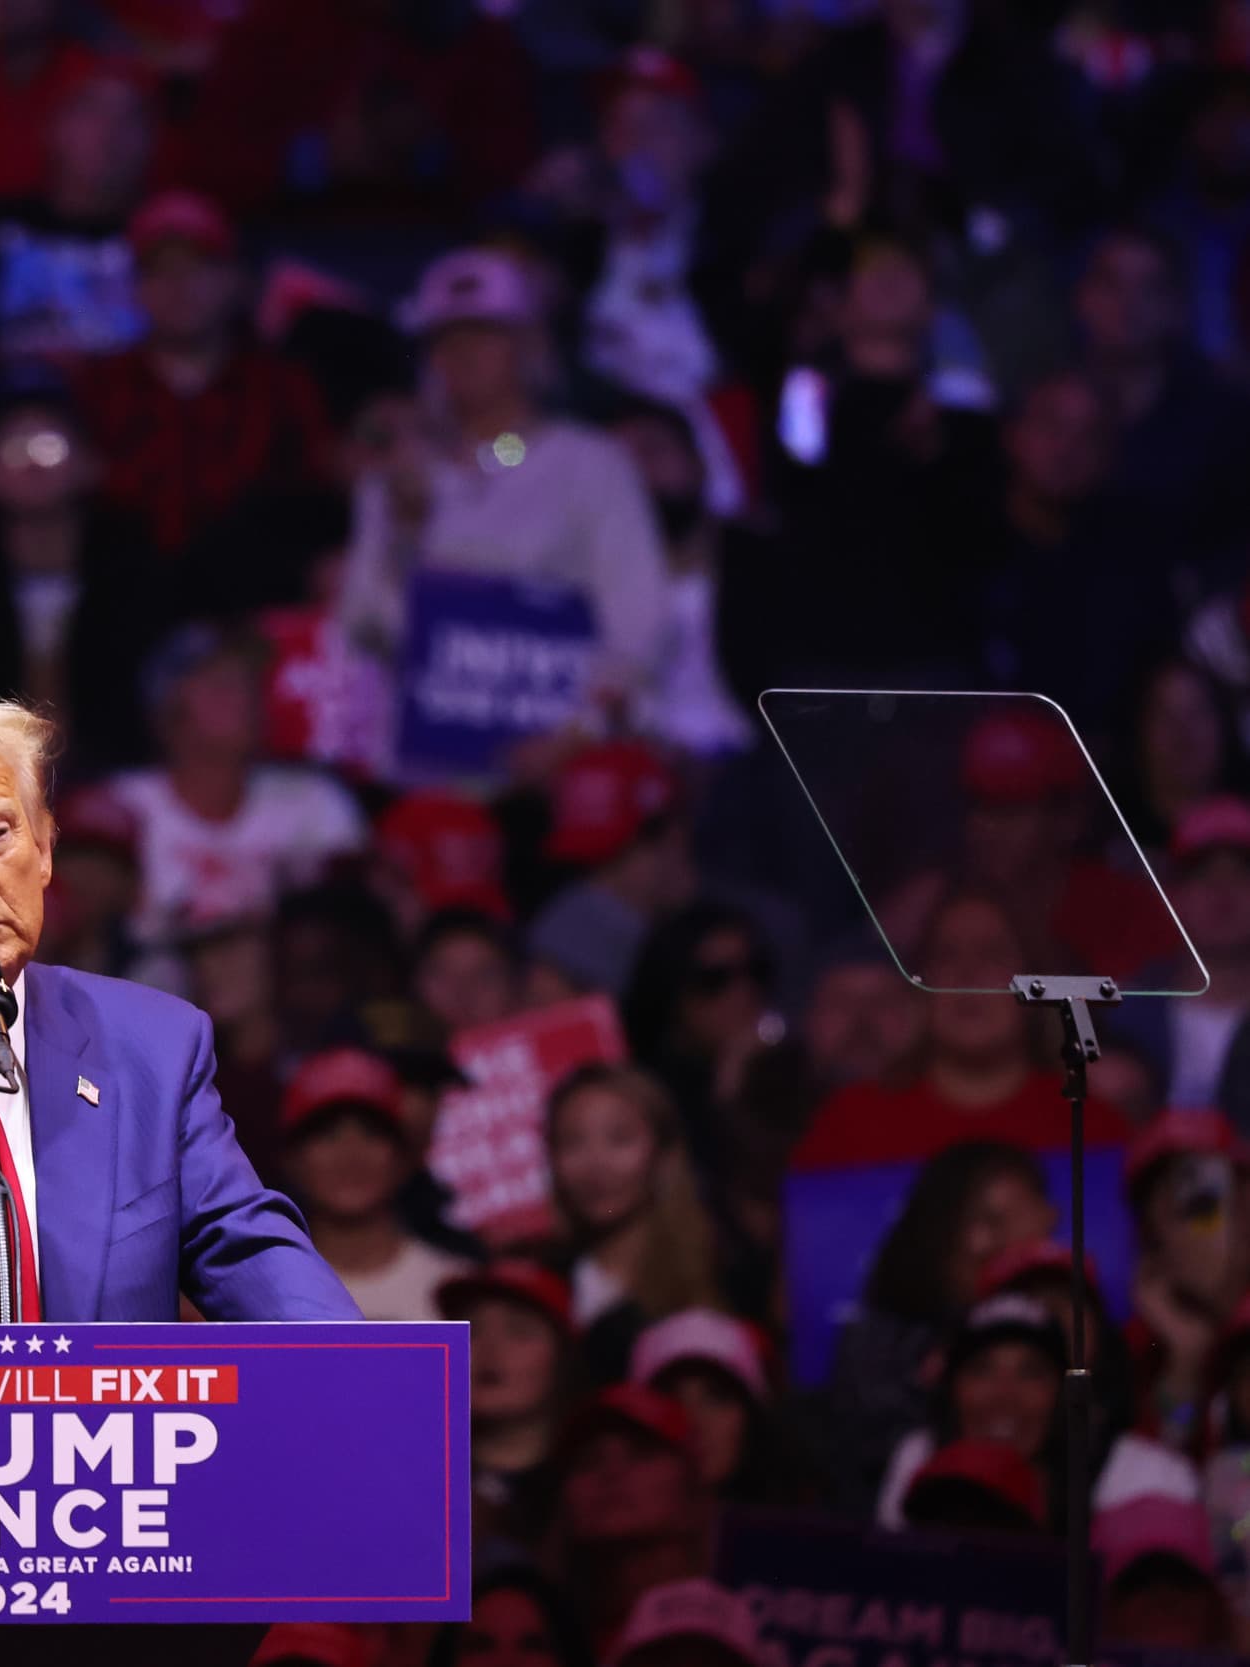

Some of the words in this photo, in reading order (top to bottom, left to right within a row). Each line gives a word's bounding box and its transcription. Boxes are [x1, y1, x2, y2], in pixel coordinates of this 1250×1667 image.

[91, 1368, 164, 1402] FIX
[177, 1368, 218, 1402] IT
[18, 1556, 98, 1575] GREAT
[106, 1556, 192, 1574] AGAIN!
